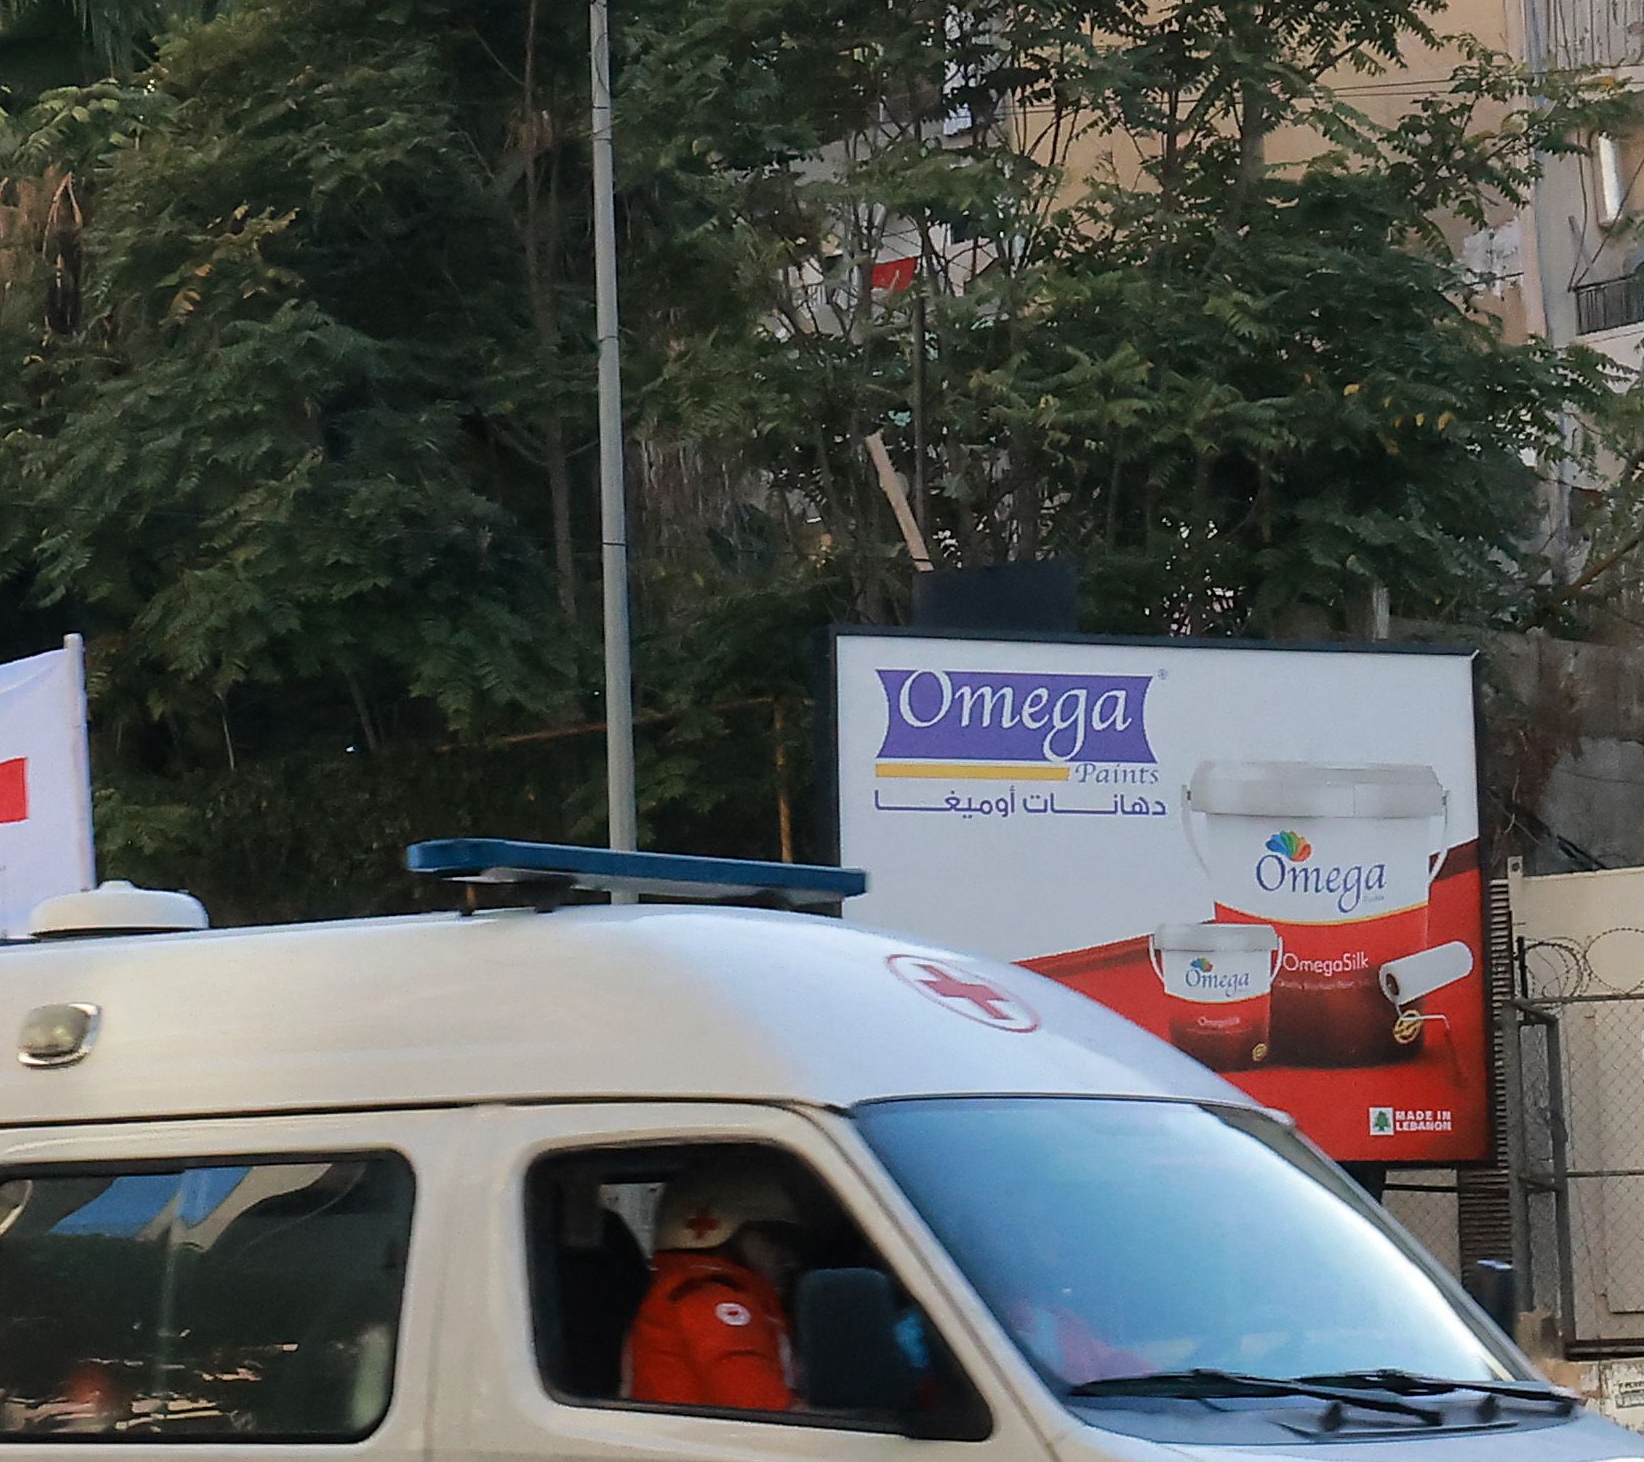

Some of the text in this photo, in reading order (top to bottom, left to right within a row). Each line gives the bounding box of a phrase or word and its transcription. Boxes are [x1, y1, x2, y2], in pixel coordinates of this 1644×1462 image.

[899, 668, 1133, 763] Omega
[1074, 763, 1160, 785] Paints
[874, 786, 1168, 819] دهانات أوميغا
[1255, 853, 1387, 914] Omega
[1282, 951, 1370, 977] OmegaSilk
[1185, 968, 1251, 998] Omega
[1395, 1110, 1452, 1120] MADE IN
[1395, 1121, 1453, 1132] LEBANON
